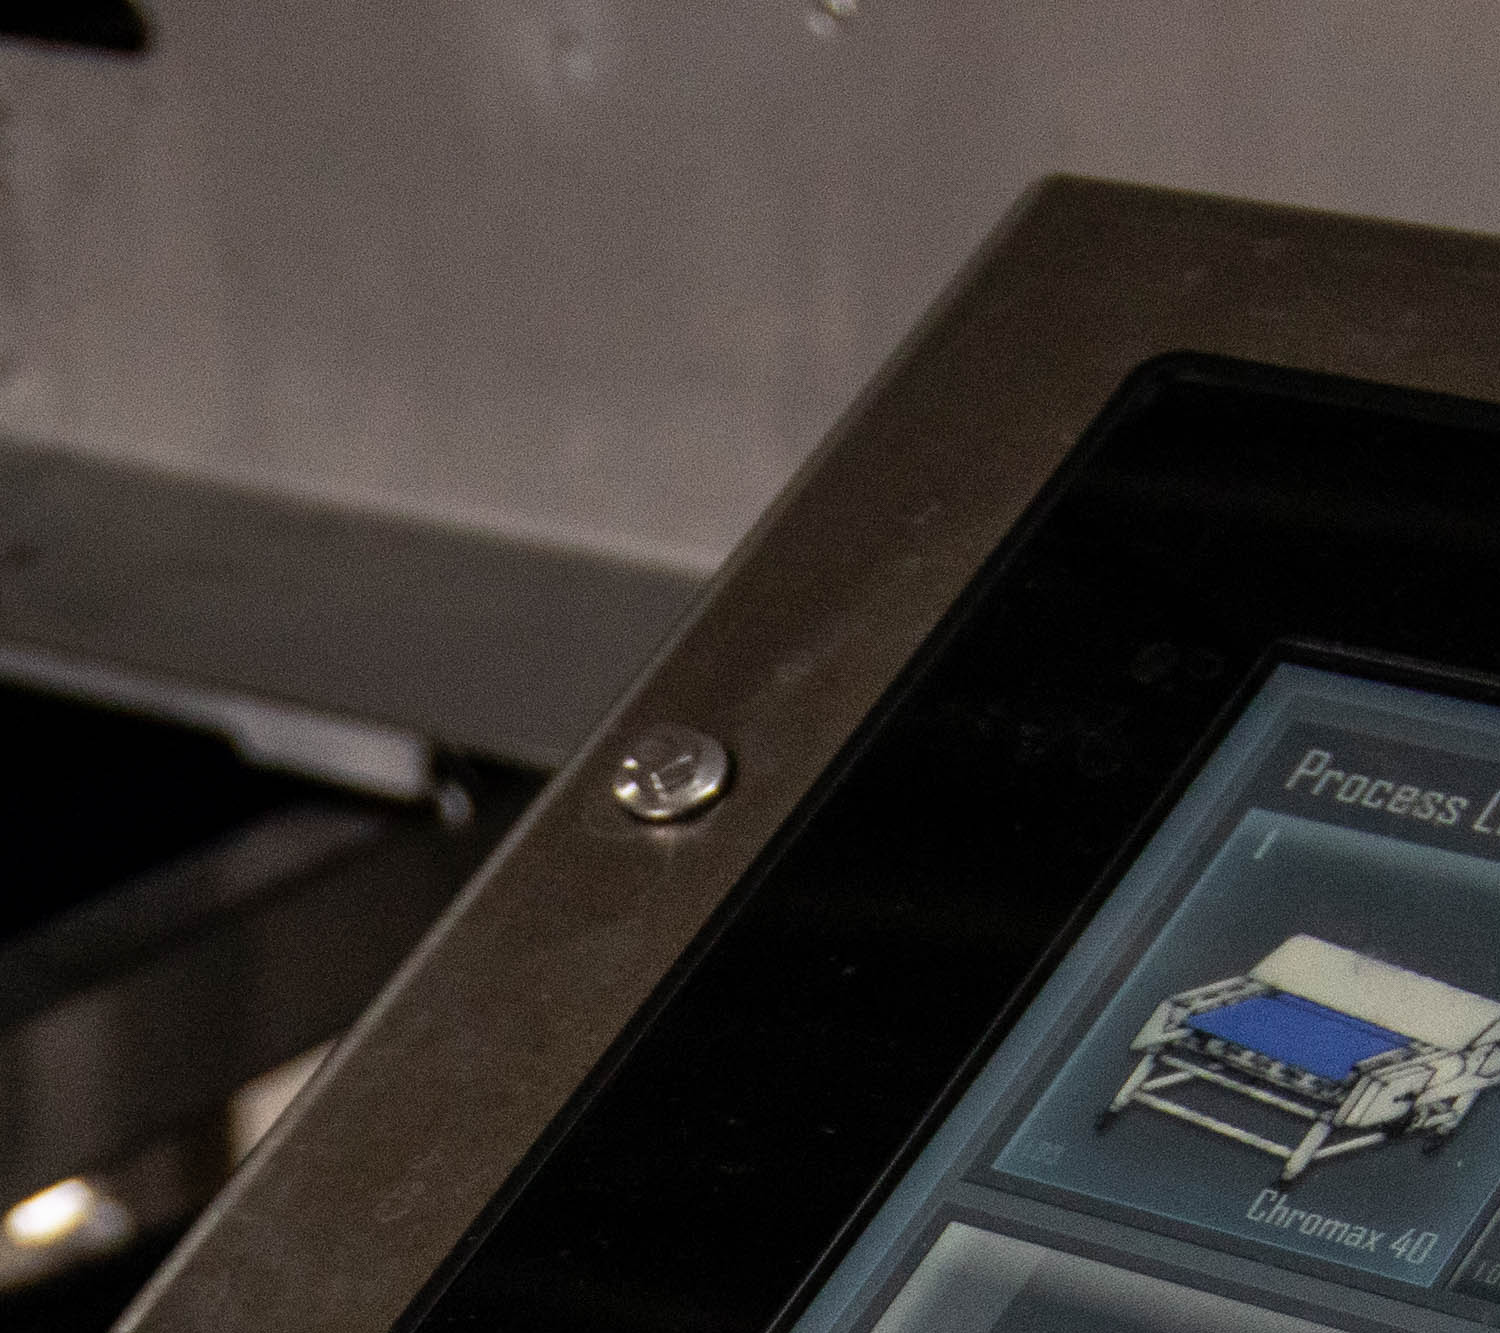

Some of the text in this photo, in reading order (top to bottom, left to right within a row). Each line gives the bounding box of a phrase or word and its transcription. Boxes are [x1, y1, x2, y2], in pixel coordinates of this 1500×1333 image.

[1285, 750, 1467, 826] Process
[1255, 832, 1275, 859] 1
[1246, 1189, 1437, 1264] Chromax 40
